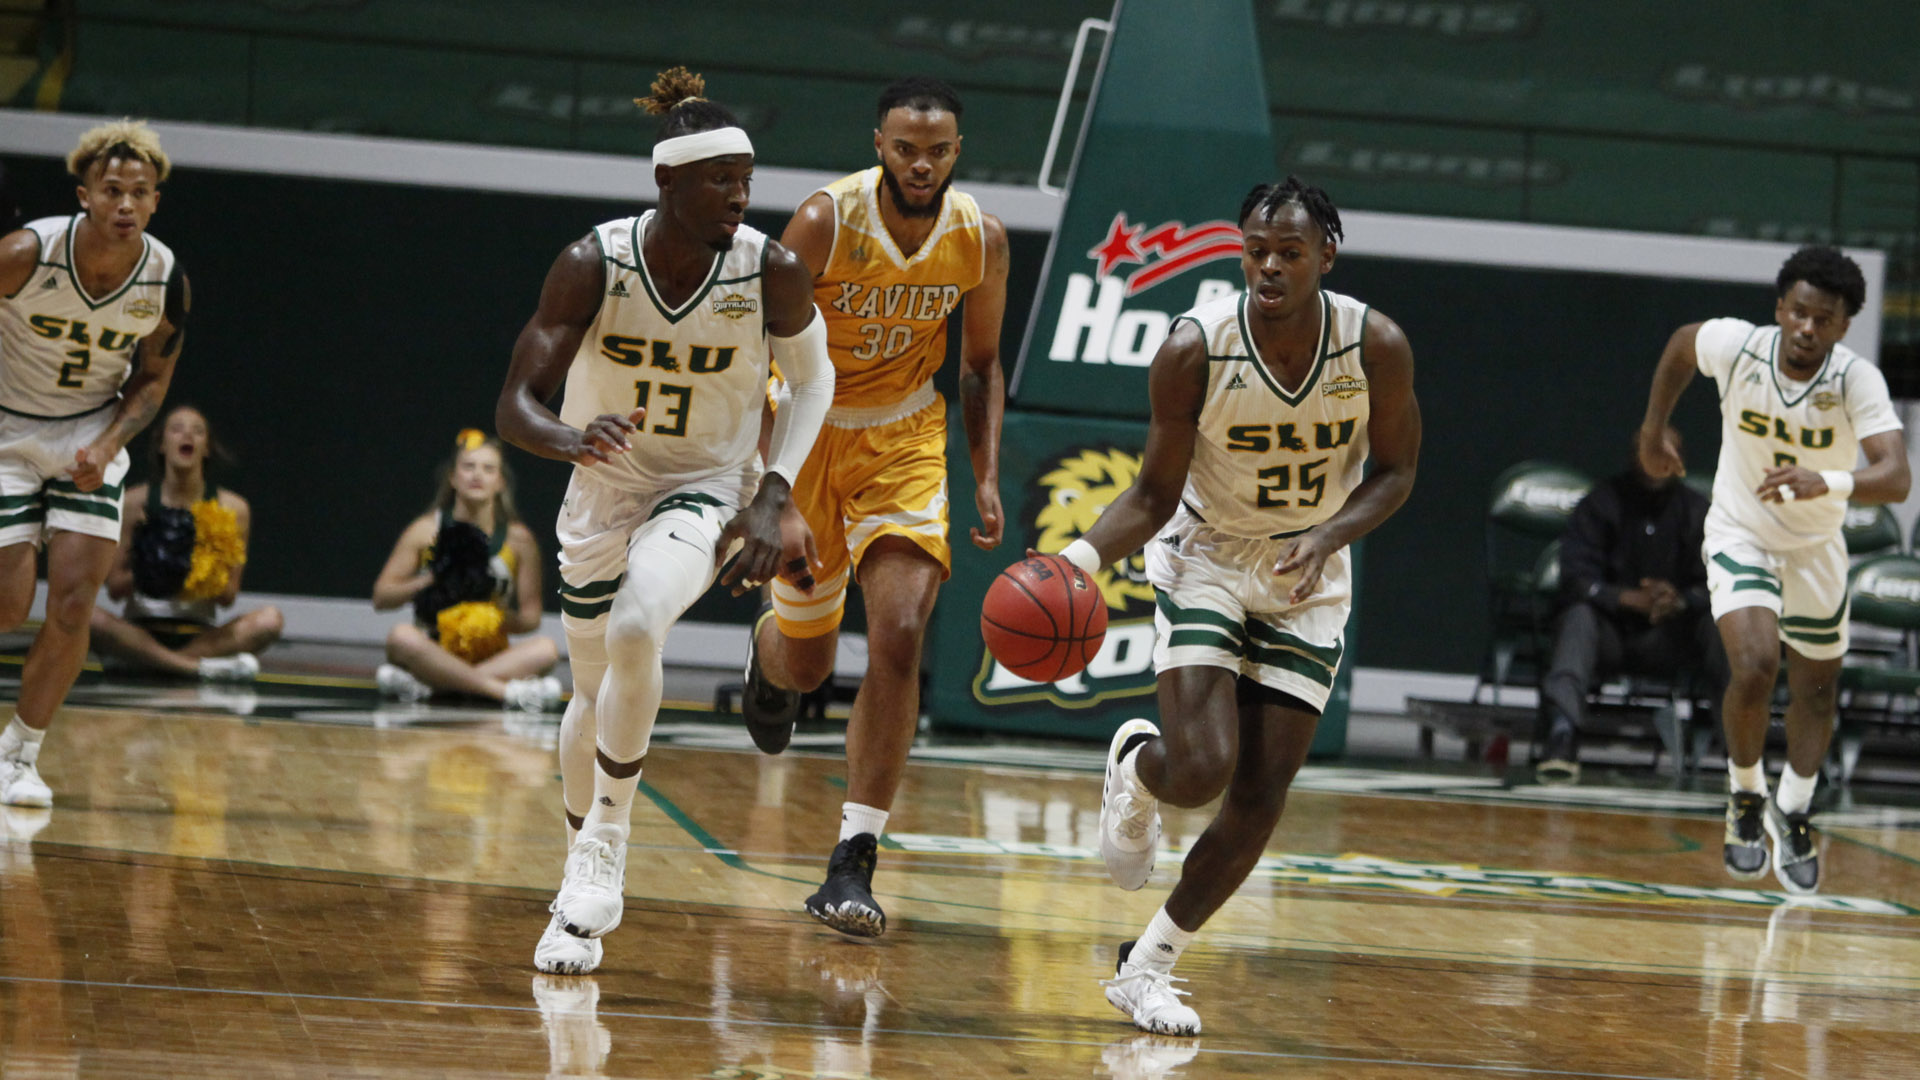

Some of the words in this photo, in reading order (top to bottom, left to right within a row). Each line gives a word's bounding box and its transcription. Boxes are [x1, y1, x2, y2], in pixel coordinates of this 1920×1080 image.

[713, 300, 757, 314] SOUTHLAND
[832, 281, 960, 321] XAVIER
[852, 323, 914, 361] 30
[57, 349, 91, 388] 2
[1322, 380, 1368, 396] SOUTHLAND
[633, 380, 693, 438] 13
[1256, 456, 1330, 508] 25
